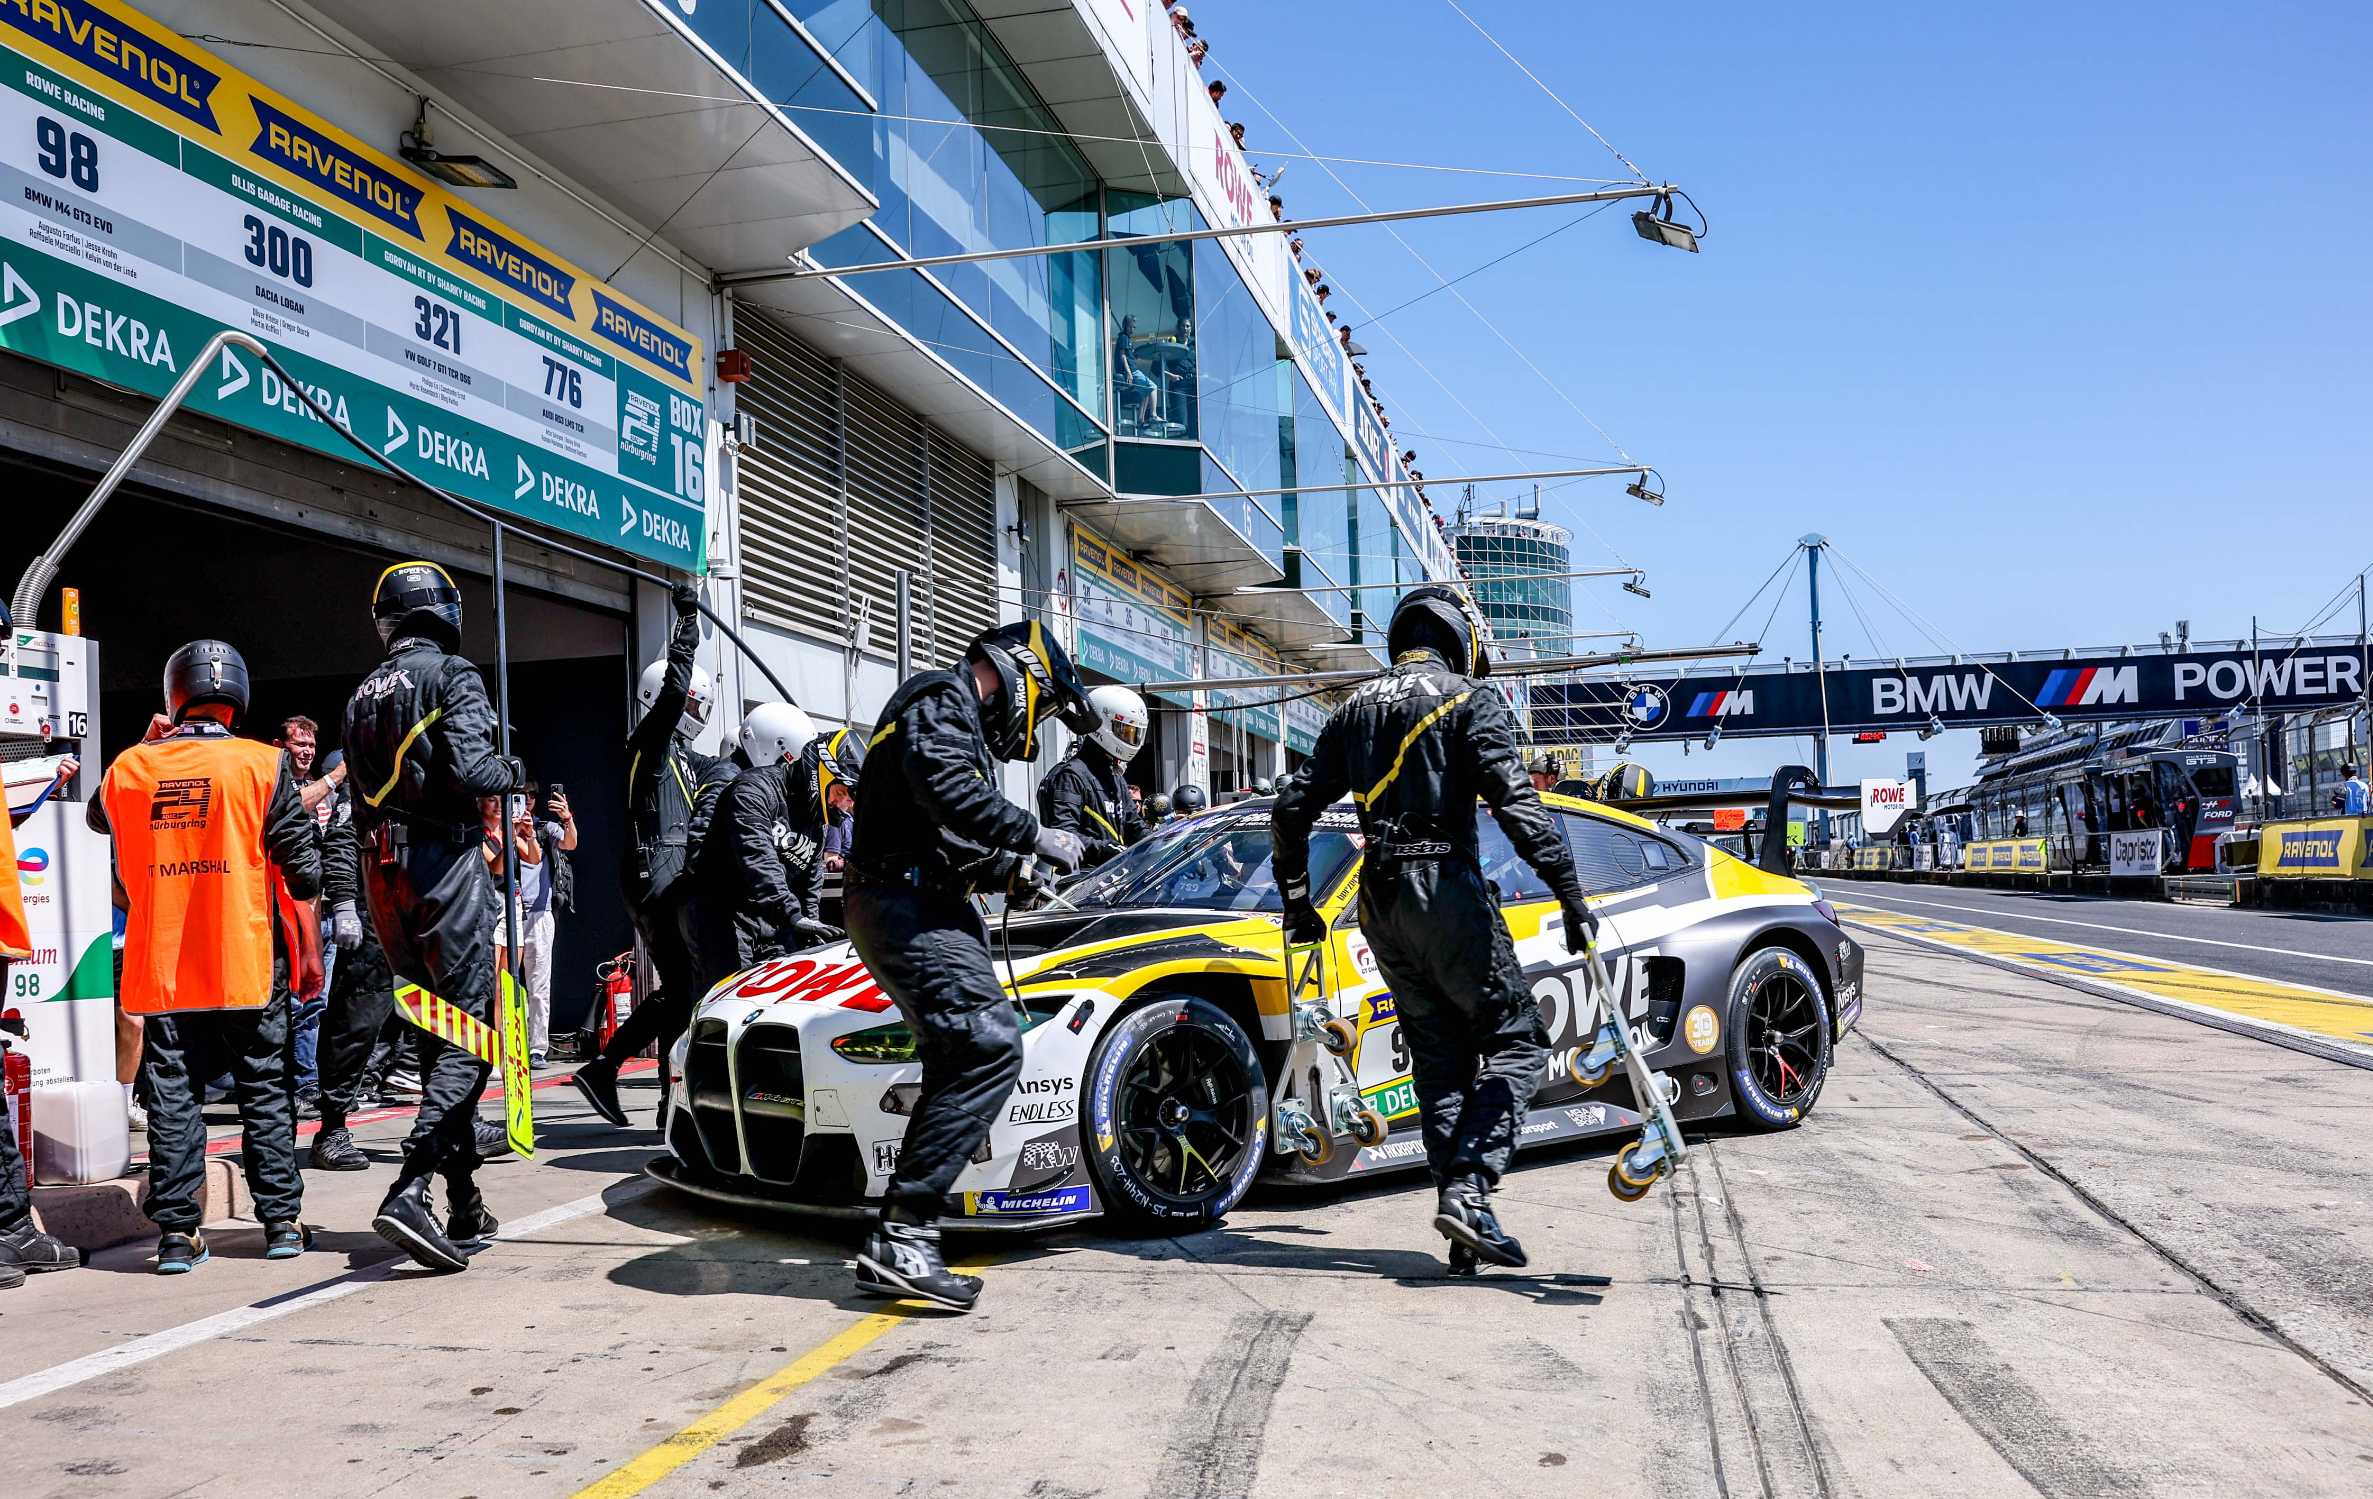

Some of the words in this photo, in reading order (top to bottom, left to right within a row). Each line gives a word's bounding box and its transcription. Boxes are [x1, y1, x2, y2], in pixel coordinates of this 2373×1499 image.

[25, 70, 61, 100] ROWE
[64, 89, 105, 121] RACING
[36, 115, 99, 193] 98
[268, 121, 411, 220] RAVENOL
[24, 186, 52, 209] BMW
[55, 199, 71, 217] M4
[73, 208, 92, 226] GT3
[94, 216, 113, 234] EVO
[231, 174, 256, 195] OLLIS
[257, 186, 291, 213] GARAGE
[292, 204, 322, 228] RACING
[29, 228, 54, 246] Raffaele
[54, 237, 81, 257] Marciello
[38, 220, 62, 239] Augusto
[62, 230, 81, 245] Farfus
[84, 239, 100, 253] Jesse
[102, 246, 118, 260] Krohn
[243, 214, 313, 289] 300
[459, 226, 566, 304] RAVENOL
[255, 285, 279, 305] DACIA
[463, 288, 486, 310] RACING
[57, 291, 176, 374] DEKRA
[414, 295, 461, 356] 321
[602, 306, 684, 368] RAVENOL
[404, 348, 416, 363] VW
[417, 354, 432, 369] GOLF
[433, 360, 437, 370] 7
[261, 367, 352, 431] DEKRA
[542, 355, 582, 409] 776
[670, 393, 703, 439] BOX
[418, 424, 489, 482] DEKRA
[620, 440, 657, 466] nürburgring
[671, 432, 703, 503] 16
[542, 471, 600, 520] DEKRA
[643, 509, 691, 552] DEKRA
[1872, 672, 1995, 715] BMW
[2173, 654, 2362, 701] POWER
[69, 713, 87, 736] 16
[161, 780, 209, 789] RAVENOL
[1662, 781, 1719, 793] HYUNDAI
[1872, 787, 1905, 804] ROWE
[2204, 810, 2233, 819] FORD
[159, 860, 231, 877] MARSHAL
[2283, 840, 2335, 858] RAVENOL
[23, 893, 50, 904] ergies
[15, 973, 40, 997] 98
[1530, 955, 1650, 1046] OWE
[1391, 1025, 1411, 1074] 9
[1010, 1076, 1074, 1096] Ansys
[1100, 1038, 1129, 1118] MICHELIN
[1384, 1080, 1420, 1116] DEK
[1009, 1099, 1075, 1123] ENDLESS
[1033, 1145, 1079, 1170] KW
[1385, 1138, 1427, 1159] AKRAPOV
[1000, 1194, 1077, 1210] MICHELIN
